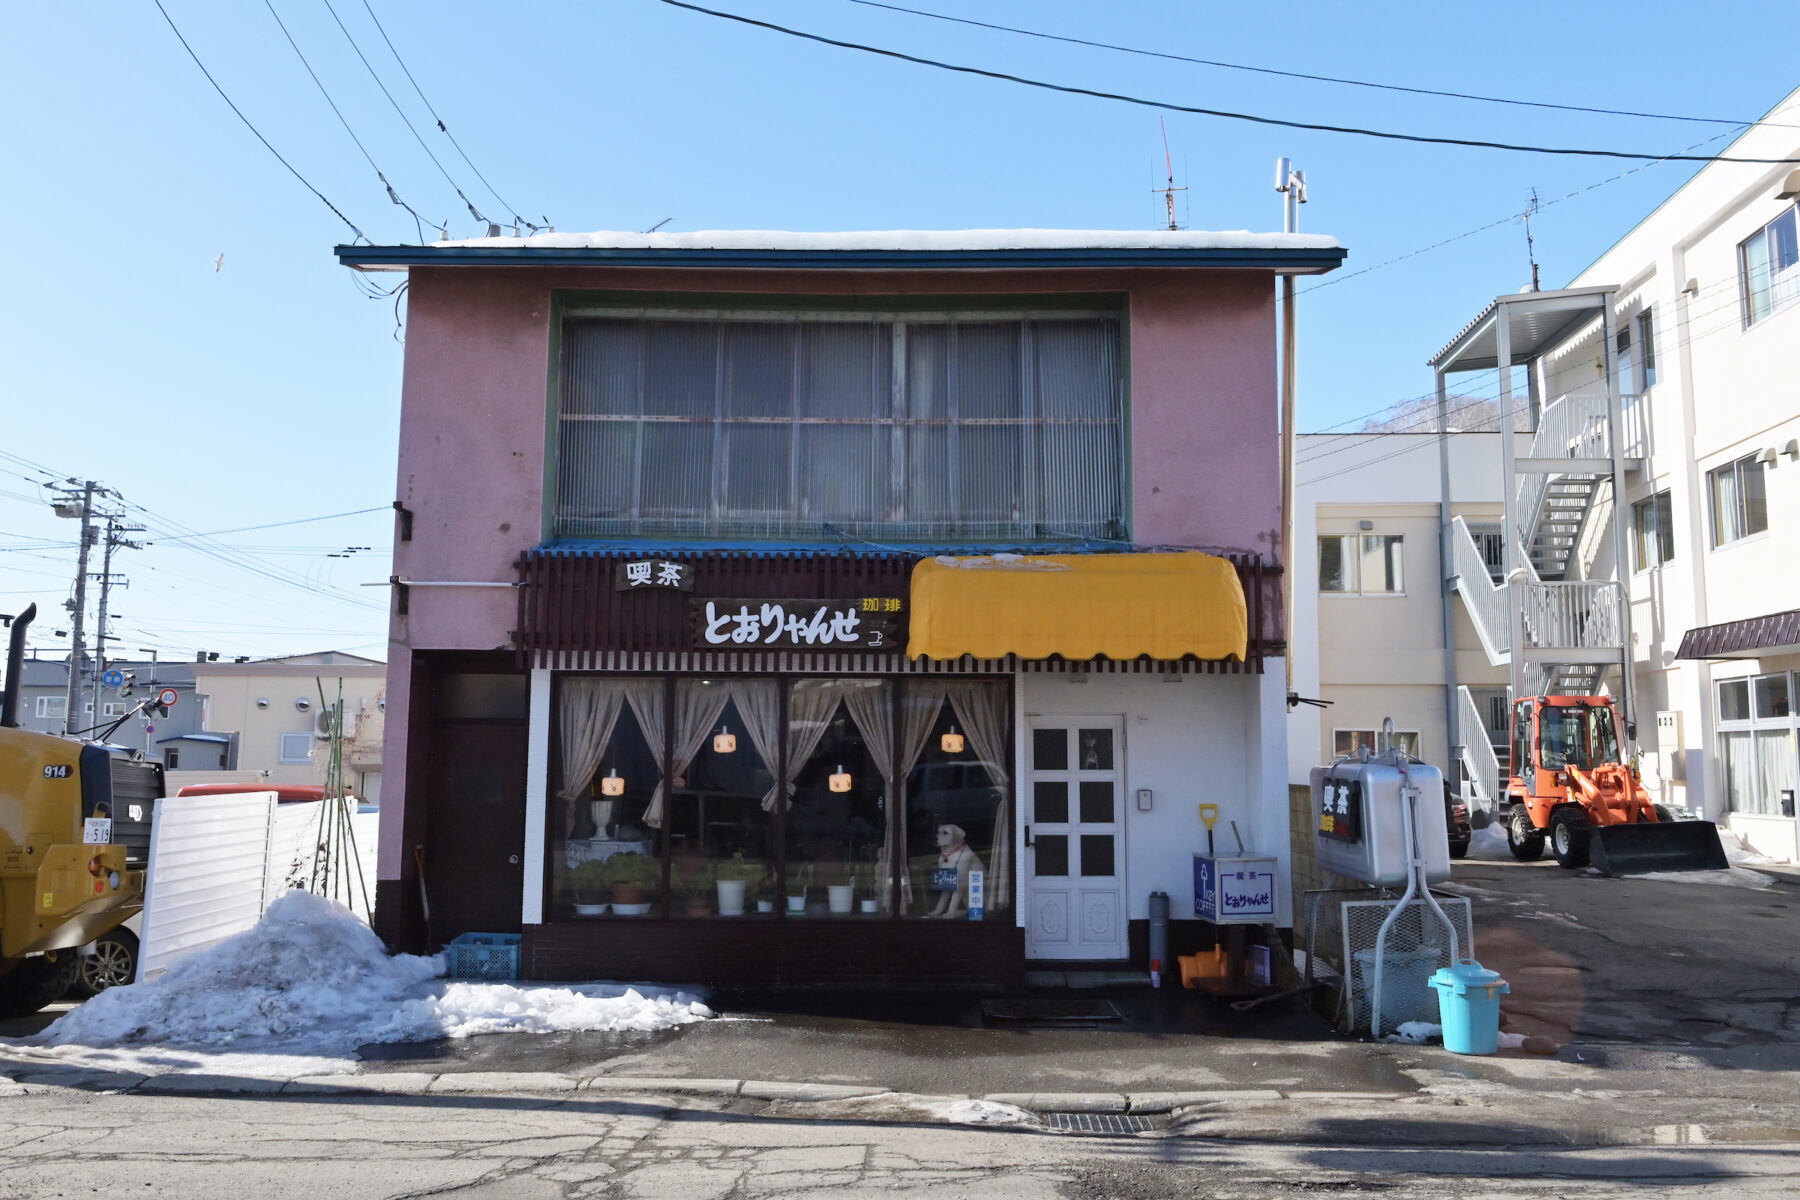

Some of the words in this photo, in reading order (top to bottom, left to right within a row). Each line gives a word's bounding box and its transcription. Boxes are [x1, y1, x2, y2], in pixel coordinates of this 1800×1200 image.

[626, 561, 683, 587] 喫茶
[863, 598, 901, 613] 珈琲
[705, 601, 861, 644] とおりゃんせ
[163, 693, 174, 701] 40
[44, 765, 66, 778] 914
[971, 873, 981, 906] 営業中
[1204, 889, 1216, 903] KEY
[1195, 898, 1216, 917] COFFEE
[1224, 891, 1270, 909] とおりゃんせ
